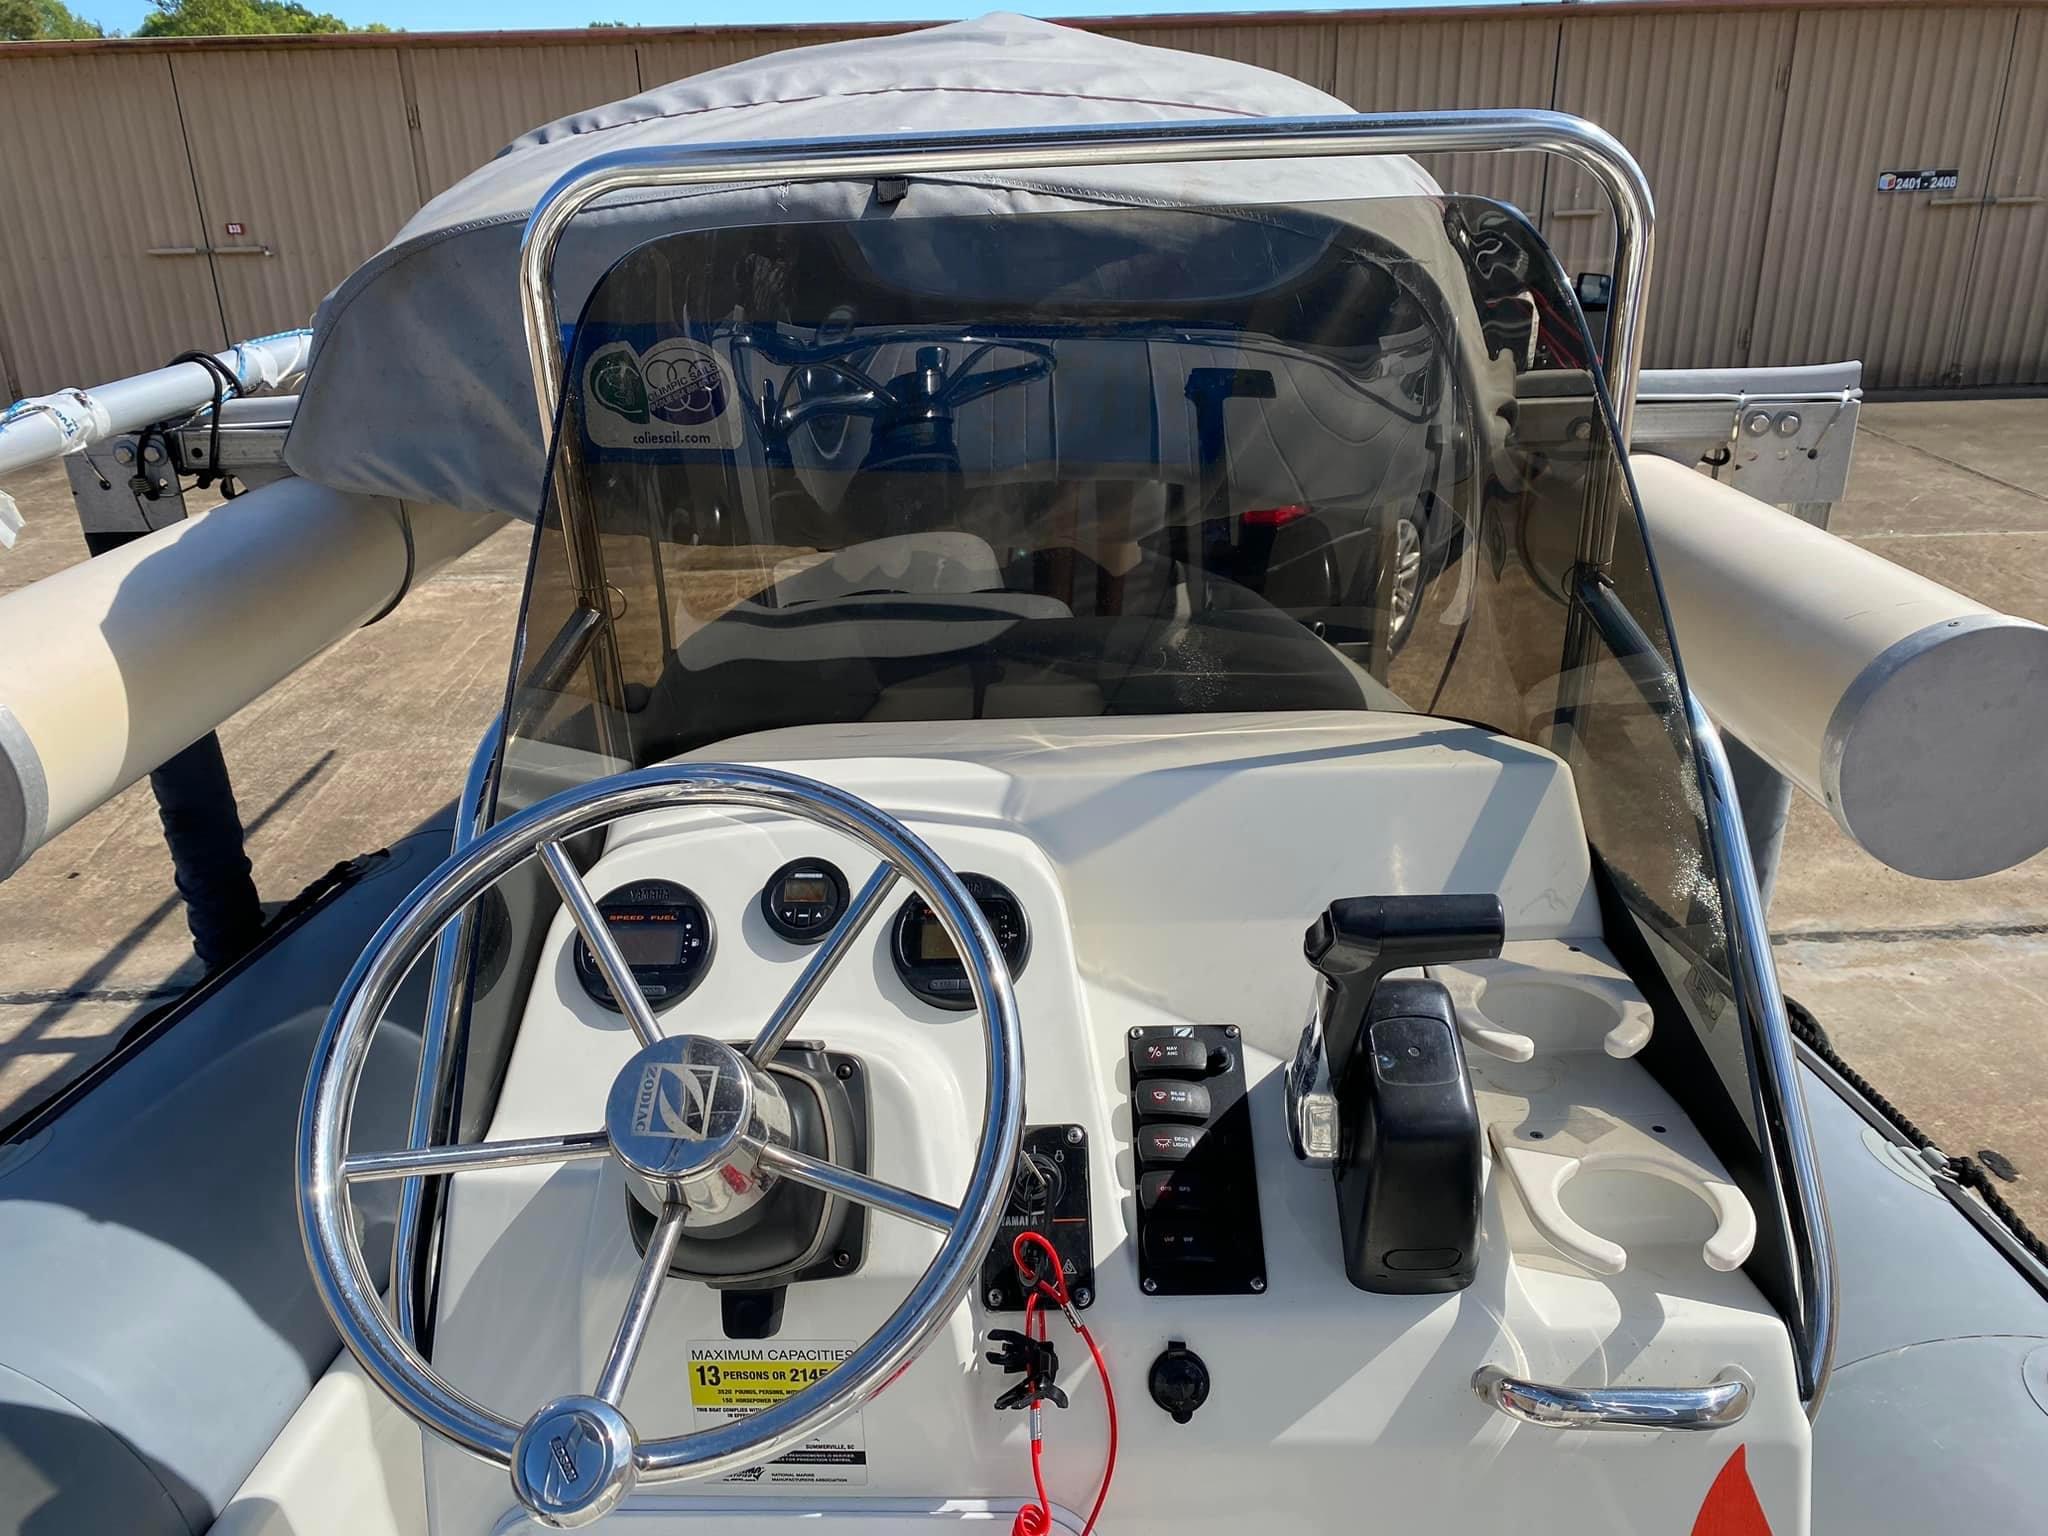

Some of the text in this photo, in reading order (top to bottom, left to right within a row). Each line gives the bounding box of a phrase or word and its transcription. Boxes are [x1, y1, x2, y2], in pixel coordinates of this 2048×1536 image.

[1895, 178, 1921, 189] 2401
[1930, 176, 1957, 188] 2408
[689, 363, 718, 381] SAILS
[53, 408, 74, 437] Tyve
[633, 431, 710, 444] coliesail.com
[631, 888, 670, 902] YAMAHA
[635, 1066, 658, 1132] ZODIAC
[691, 1349, 854, 1361] MAXIMUM CAPACITIES
[696, 1365, 721, 1386] 13
[723, 1371, 770, 1380] PERSONS
[772, 1371, 786, 1380] OR
